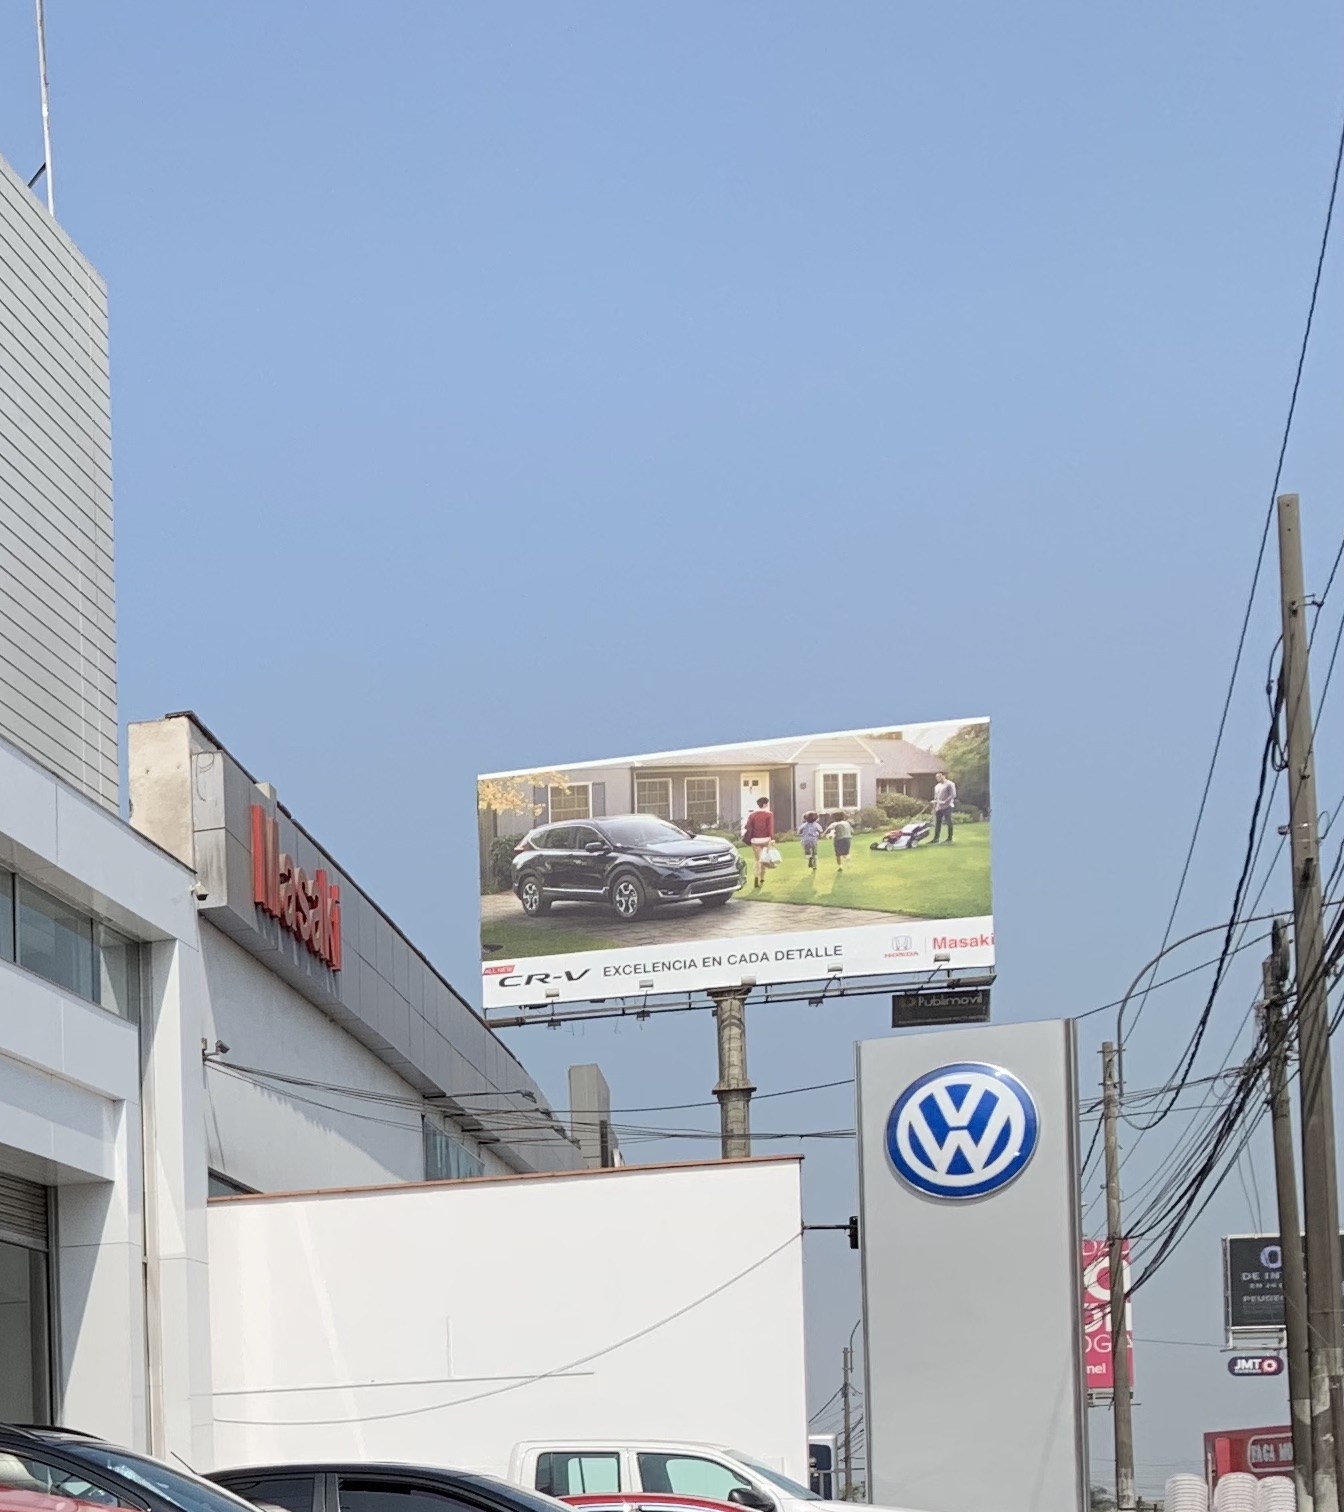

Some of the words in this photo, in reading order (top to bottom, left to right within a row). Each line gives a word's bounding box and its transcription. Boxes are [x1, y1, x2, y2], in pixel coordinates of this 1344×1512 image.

[933, 933, 995, 949] Masaki
[603, 958, 698, 977] EXCELENCIA
[702, 956, 722, 968] EN
[727, 951, 770, 965] CADA
[774, 945, 844, 961] DETALLE
[499, 968, 592, 988] CR-V
[1234, 1358, 1262, 1370] JMT
